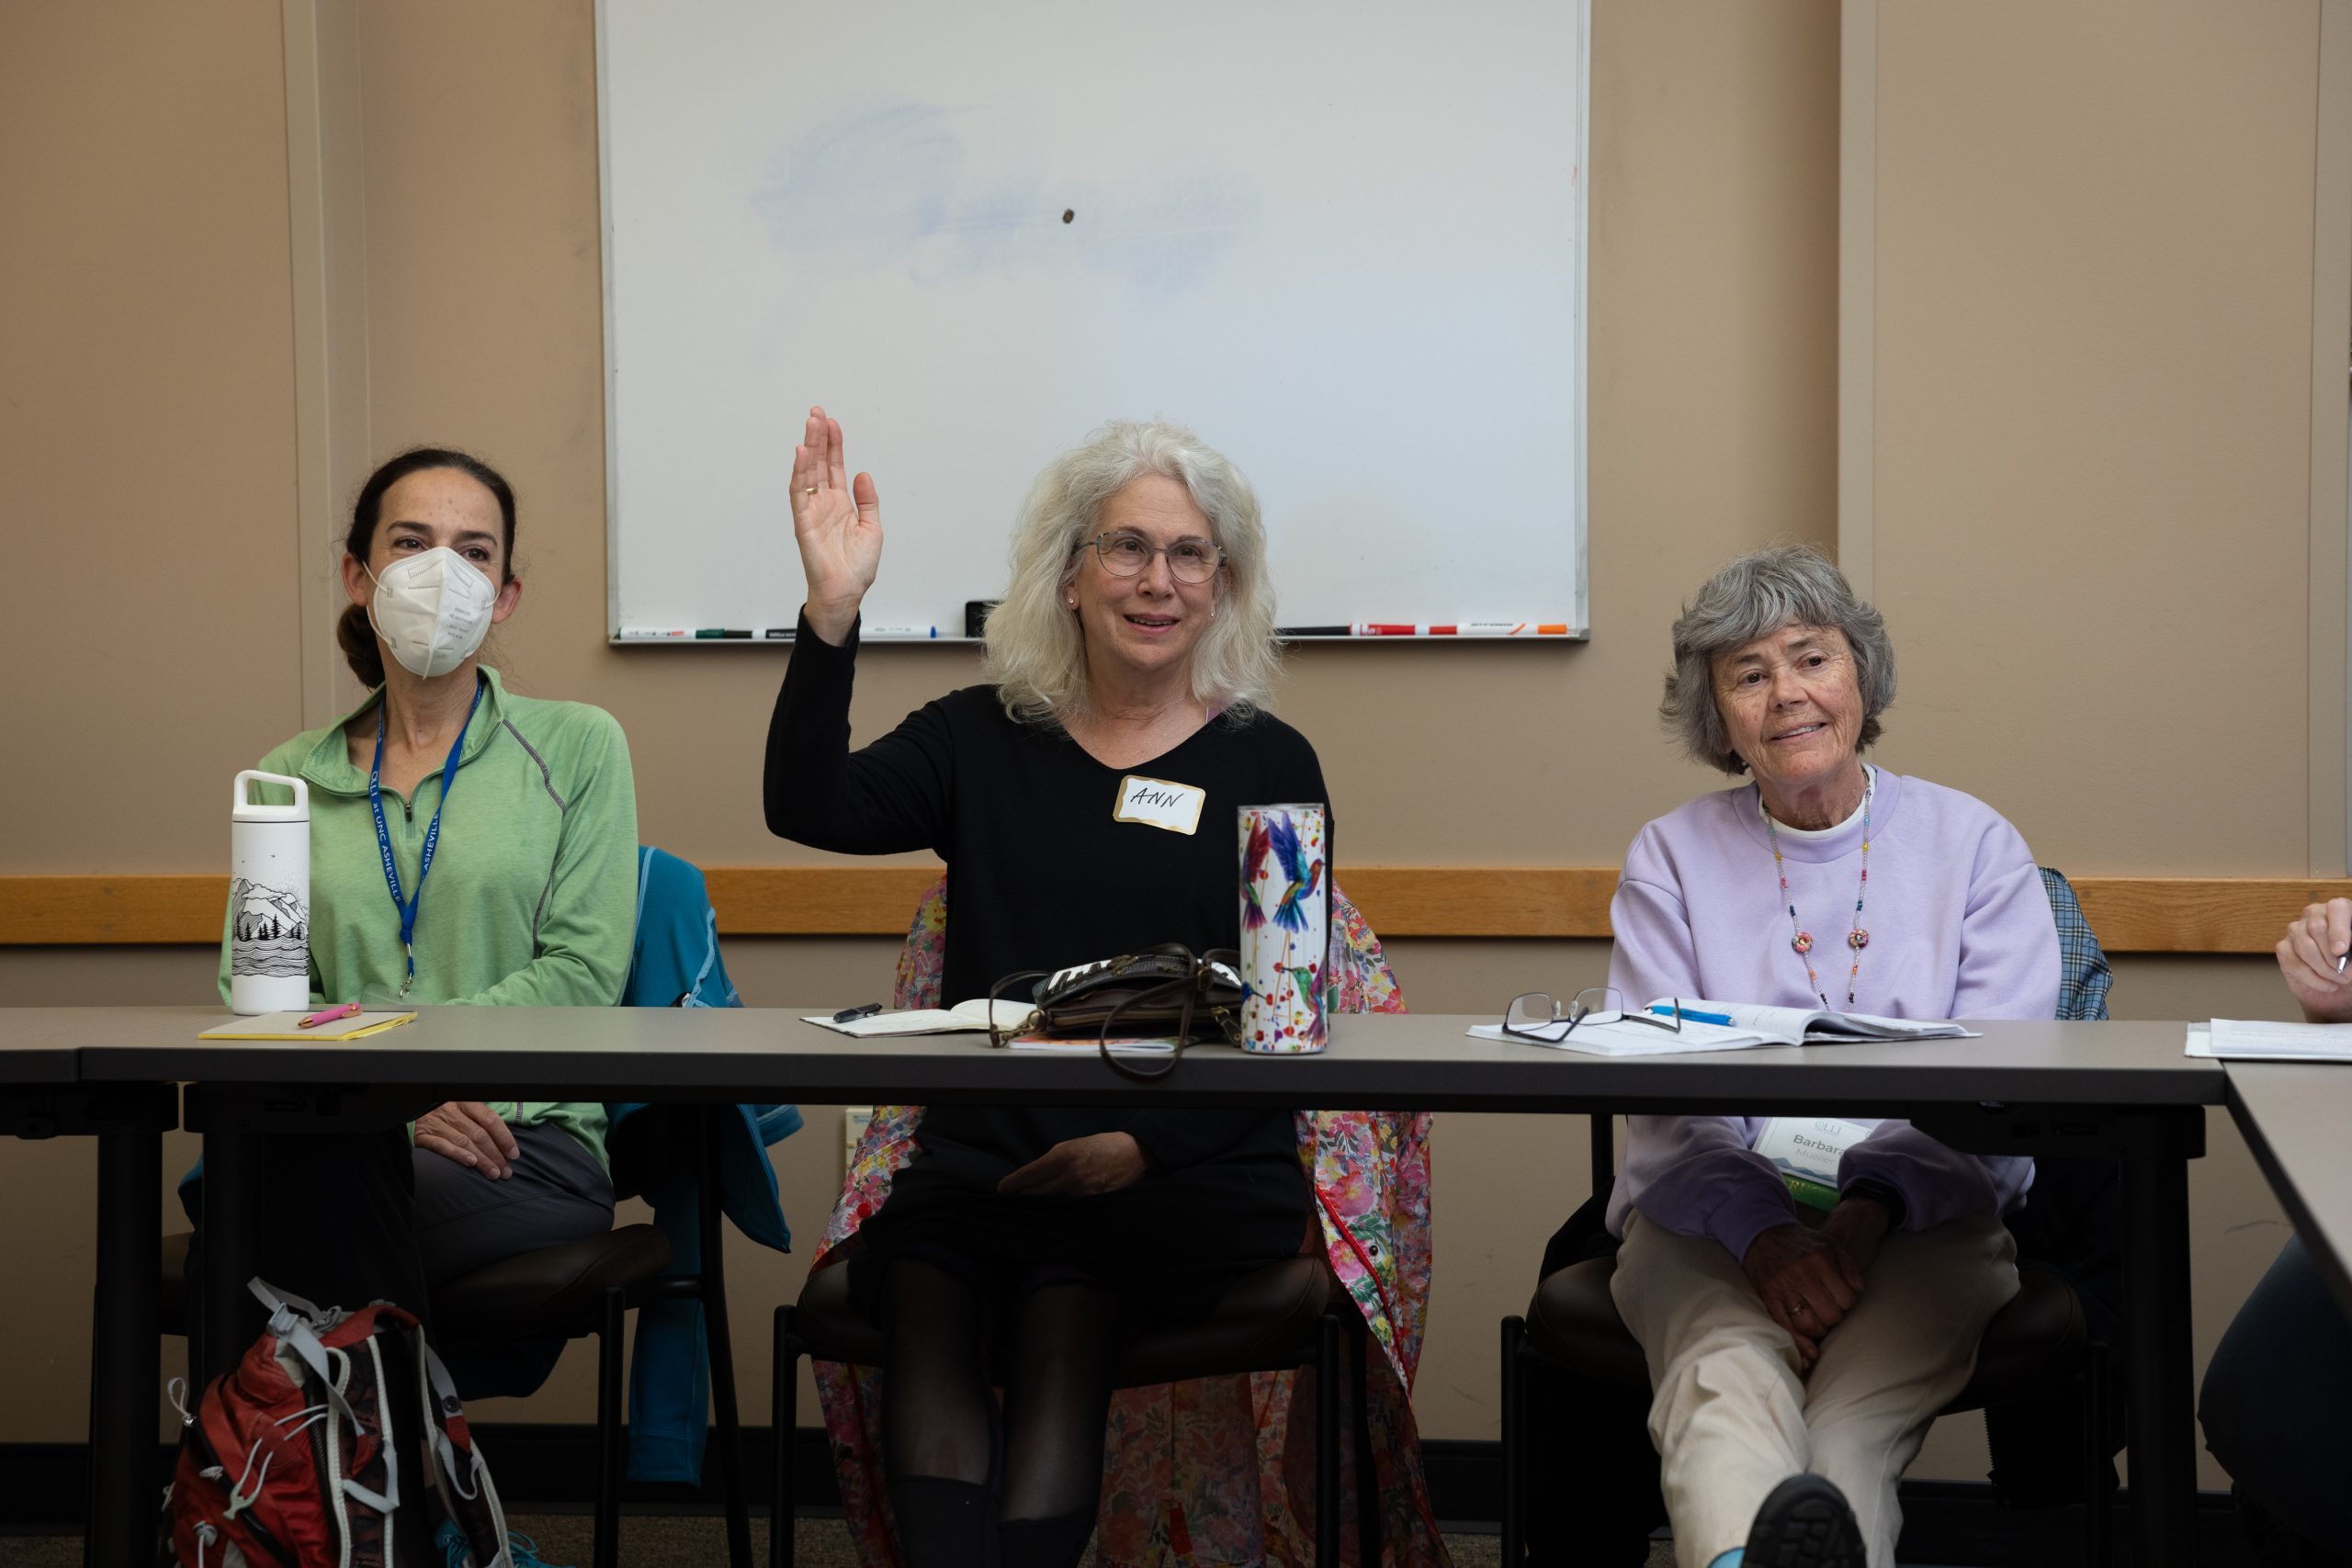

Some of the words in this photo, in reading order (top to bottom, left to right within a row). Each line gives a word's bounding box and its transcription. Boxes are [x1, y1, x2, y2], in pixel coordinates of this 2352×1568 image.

[1130, 787, 1184, 808] ANN
[373, 803, 380, 814] at
[375, 815, 387, 841] UNC
[381, 845, 401, 903] ASHEVILLE
[1792, 1134, 1845, 1156] Barbara
[1795, 1147, 1836, 1165] Mueller
